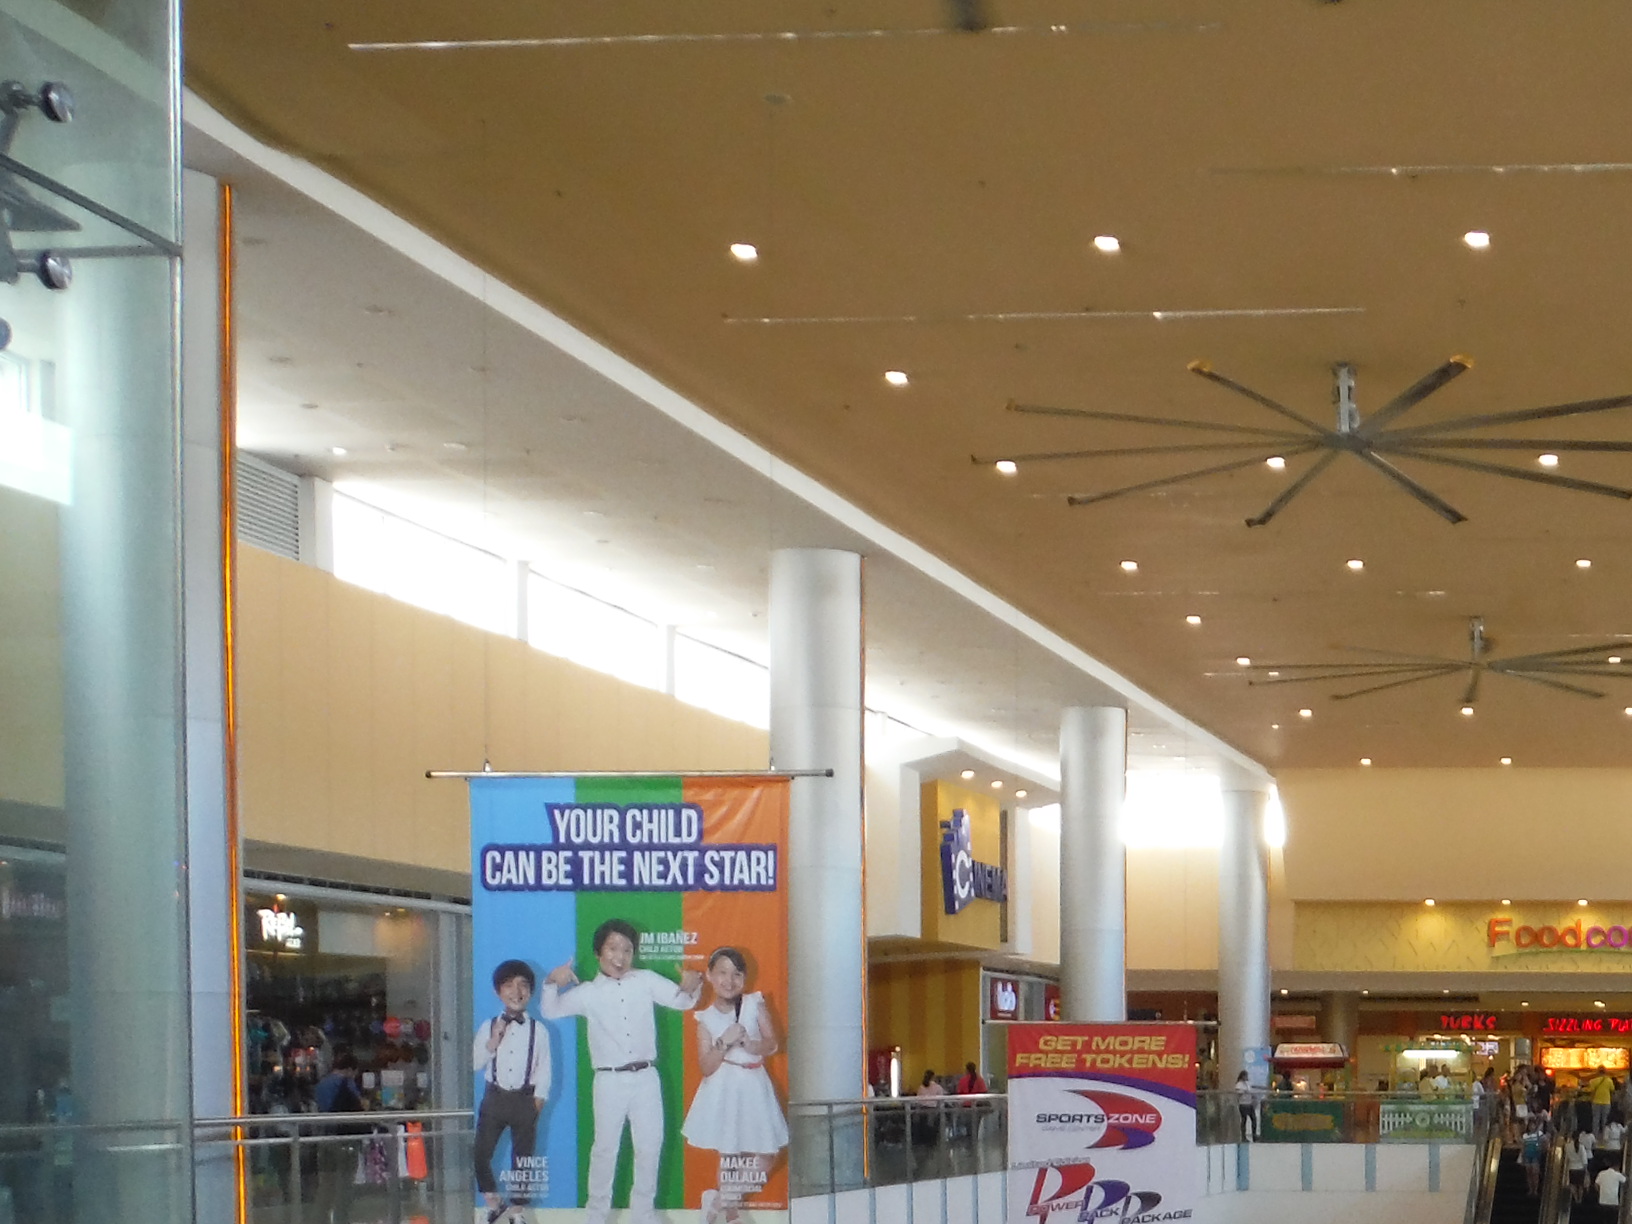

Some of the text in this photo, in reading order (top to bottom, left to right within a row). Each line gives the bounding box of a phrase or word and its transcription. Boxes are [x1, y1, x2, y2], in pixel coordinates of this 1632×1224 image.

[553, 808, 698, 844] YOUR CHILD
[485, 851, 775, 886] CAN BE THE NEXT STAR!
[1543, 1018, 1602, 1033] SIZZLING
[1039, 1036, 1166, 1050] GET MORE
[1016, 1054, 1190, 1068] FREE TOKENS!
[1036, 1113, 1156, 1124] SPORTS ZONE
[517, 1156, 548, 1168] VINCE
[500, 1170, 549, 1181] ANGELES
